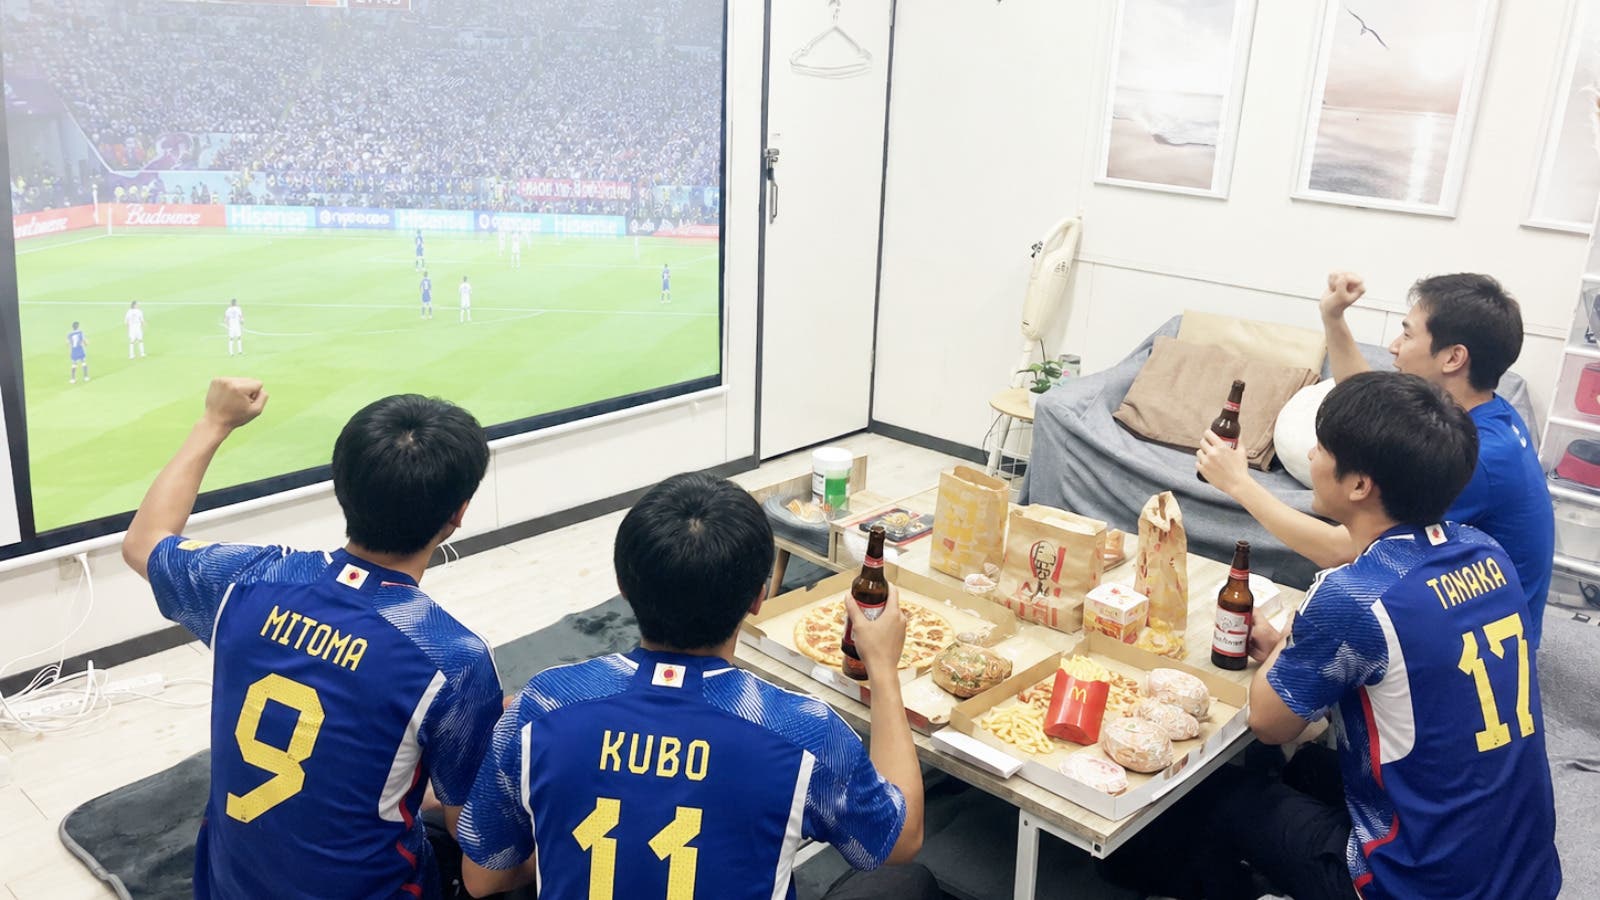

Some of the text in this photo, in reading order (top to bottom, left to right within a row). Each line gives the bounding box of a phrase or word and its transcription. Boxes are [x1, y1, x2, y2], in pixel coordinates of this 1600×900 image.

[1426, 556, 1508, 610] TANAKA
[260, 605, 368, 672] MITOMA
[1457, 612, 1536, 753] 17
[225, 672, 326, 824] 9
[599, 729, 711, 781] KUBO
[571, 797, 703, 900] 11
